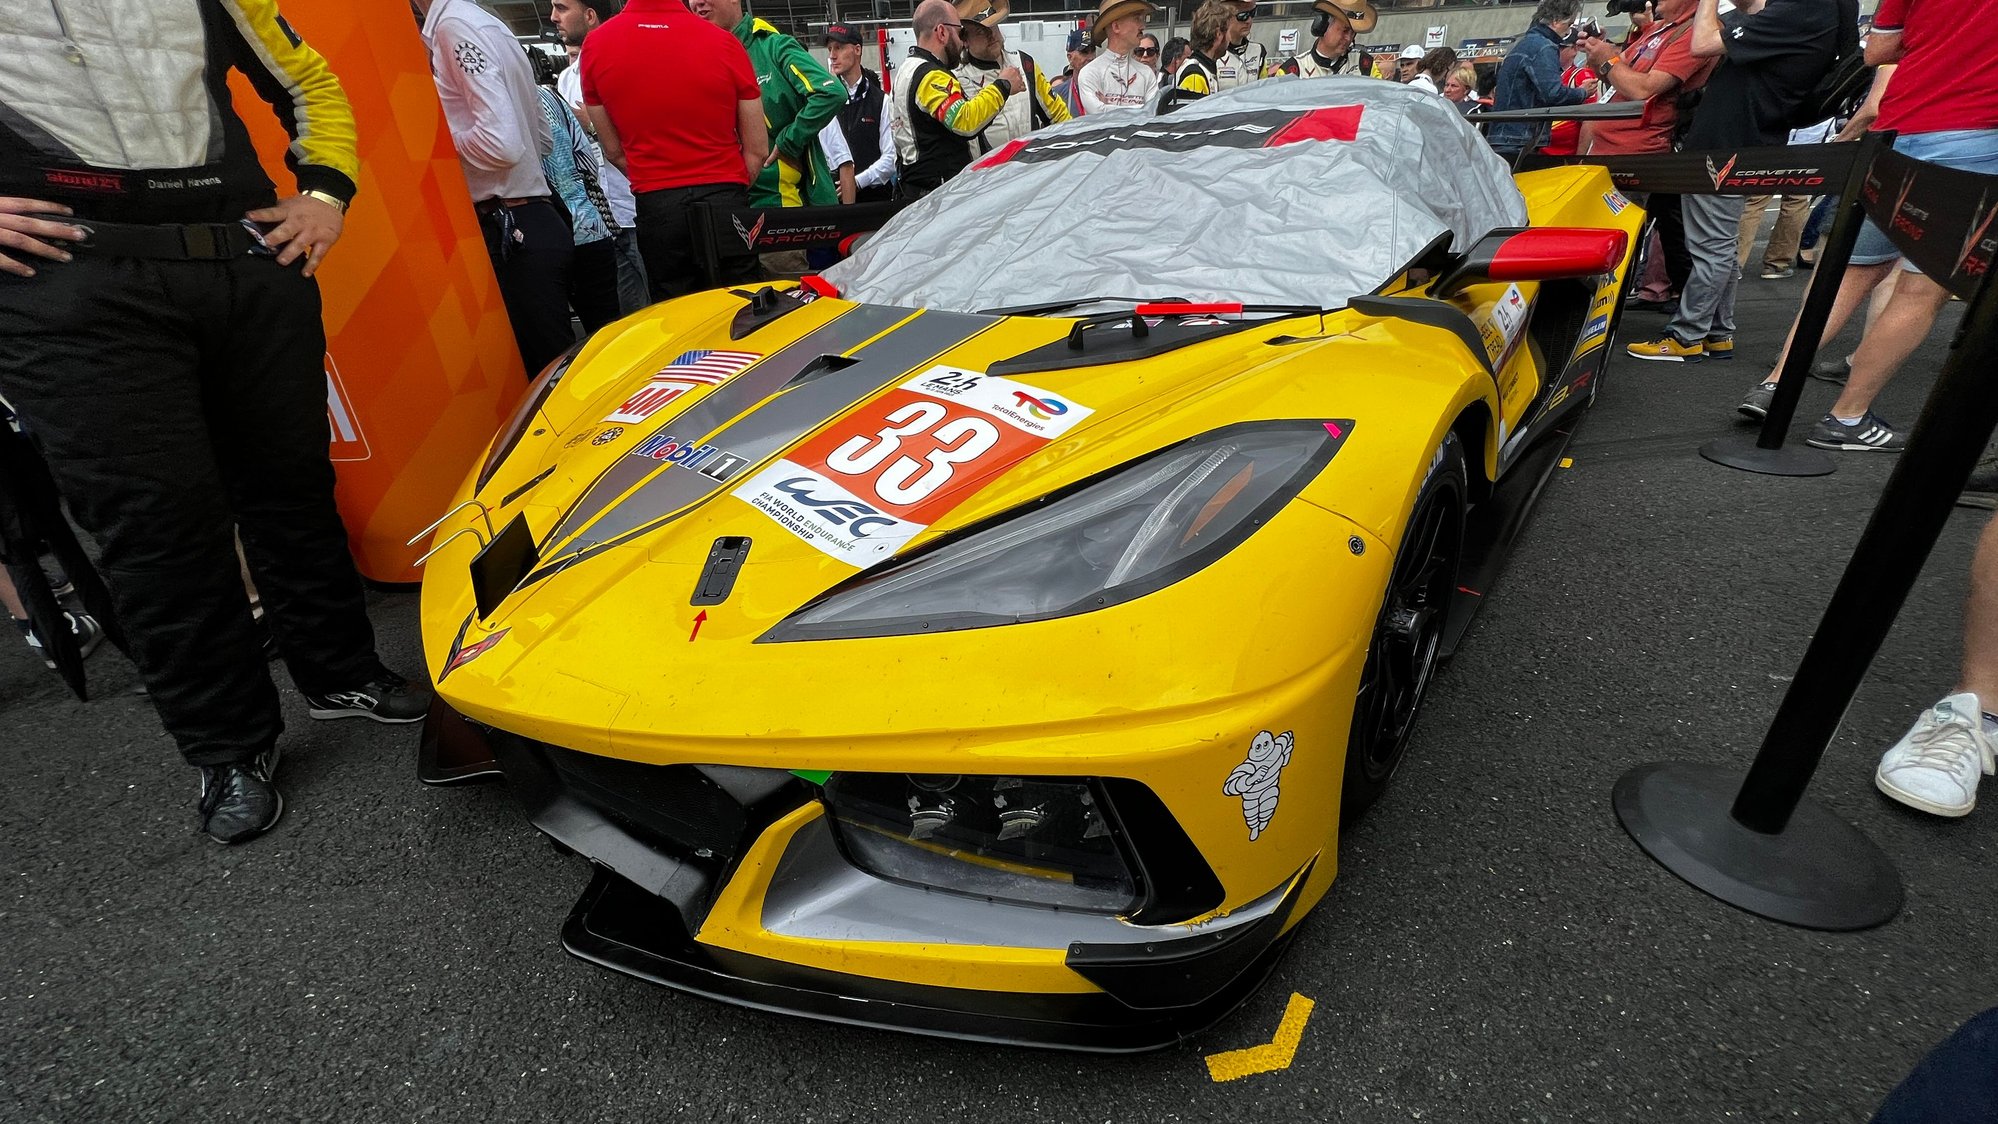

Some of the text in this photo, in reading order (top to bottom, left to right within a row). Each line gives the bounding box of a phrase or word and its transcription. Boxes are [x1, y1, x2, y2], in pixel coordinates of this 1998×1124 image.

[148, 179, 184, 190] Daniel
[1725, 176, 1825, 187] RACING
[1735, 168, 1820, 177] CORVETTE
[759, 231, 842, 244] RACING
[767, 225, 836, 235] CORVETTE
[992, 403, 1045, 431] TotalEnergies
[632, 434, 719, 470] Mobil
[825, 401, 1001, 506] 33
[751, 497, 815, 541] CHAMPIONSHIP
[759, 491, 856, 552] FIA WORLD ENDURANCE
[774, 477, 898, 538] WEC
